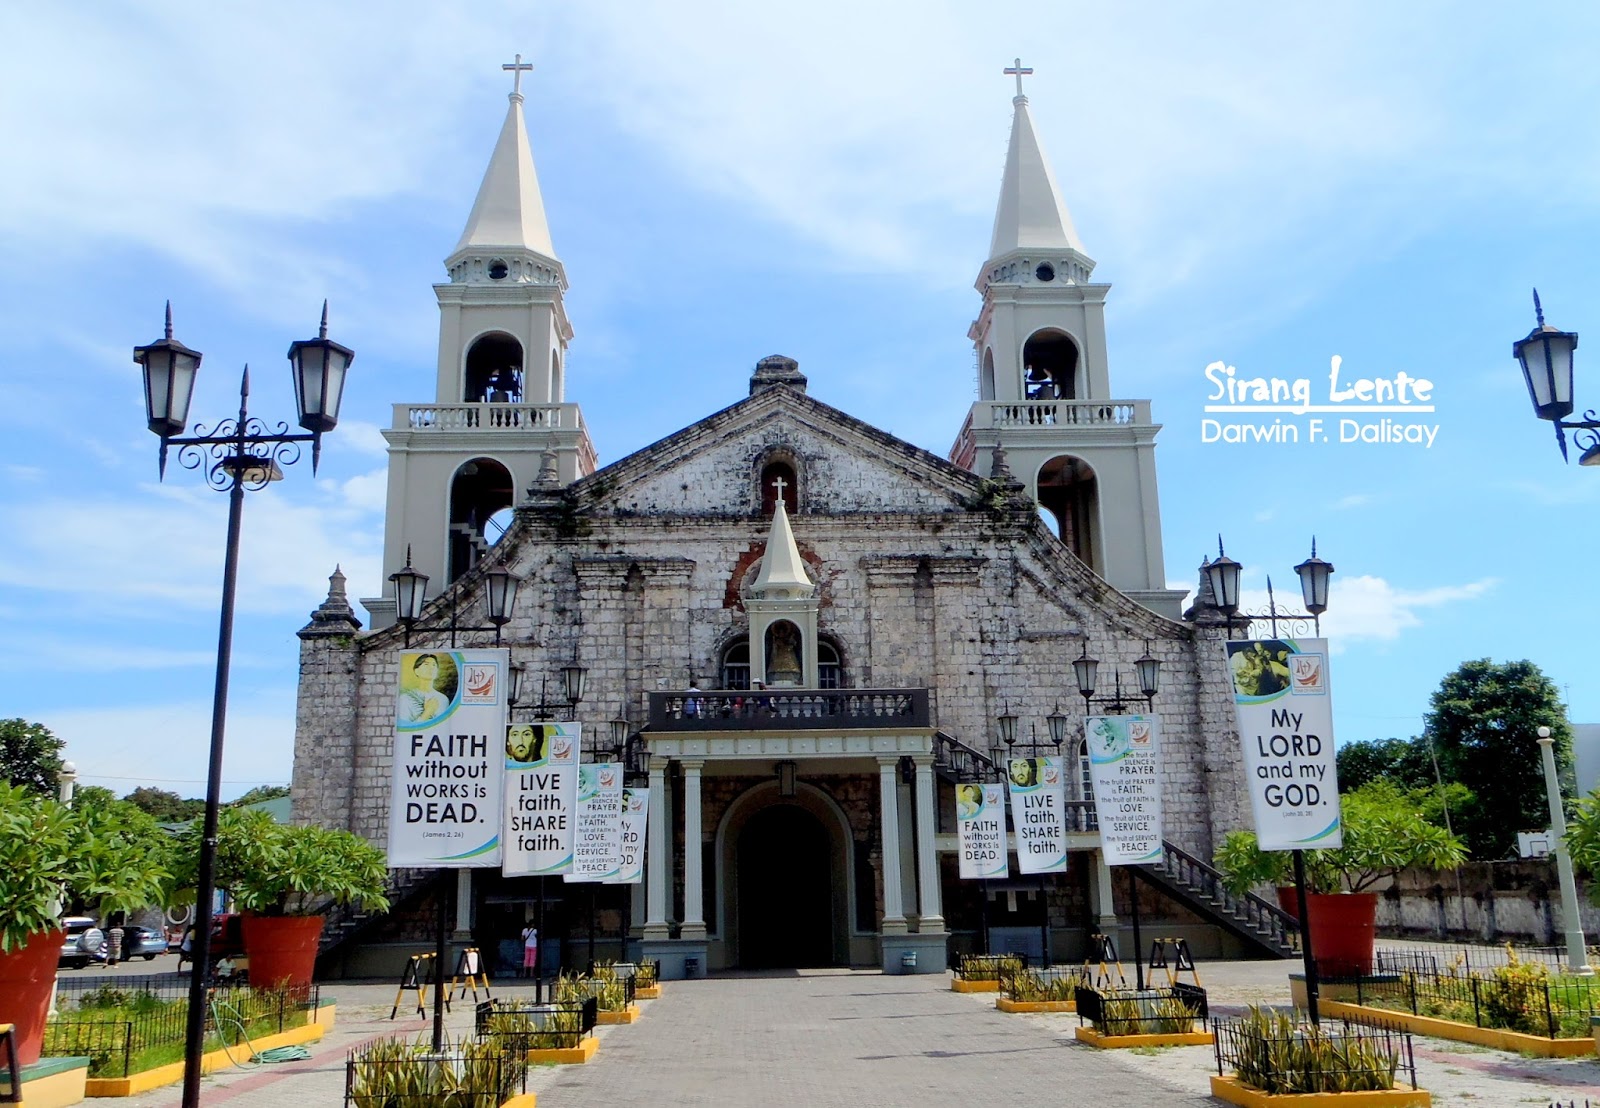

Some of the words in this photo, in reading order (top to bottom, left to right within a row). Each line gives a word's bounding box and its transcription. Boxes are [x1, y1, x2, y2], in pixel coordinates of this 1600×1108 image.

[1271, 708, 1303, 732] My
[411, 734, 487, 757] FAITH
[1257, 734, 1322, 758] LORD
[406, 760, 488, 778] without
[1119, 766, 1157, 775] PRAYER,
[1256, 761, 1293, 779] and
[1300, 763, 1326, 781] my
[520, 774, 560, 790] LIVE
[406, 783, 469, 798] WORKS
[474, 783, 487, 798] is
[1118, 785, 1145, 794] FAITH,
[1264, 783, 1327, 807] GOD.
[519, 794, 566, 812] faith,
[1024, 795, 1053, 808] LIVE
[406, 802, 484, 823] DEAD.
[1025, 810, 1059, 824] faith,
[511, 815, 566, 831] SHARE
[964, 821, 998, 831] FAITH
[1113, 822, 1150, 831] SERVICE,
[621, 832, 638, 843] RD
[963, 832, 999, 840] without
[1021, 826, 1060, 839] SHARE
[518, 834, 565, 851] faith.
[625, 845, 639, 853] my
[1028, 841, 1060, 854] faith.
[1121, 842, 1150, 852] PEACE.
[965, 850, 1000, 860] DEAD.
